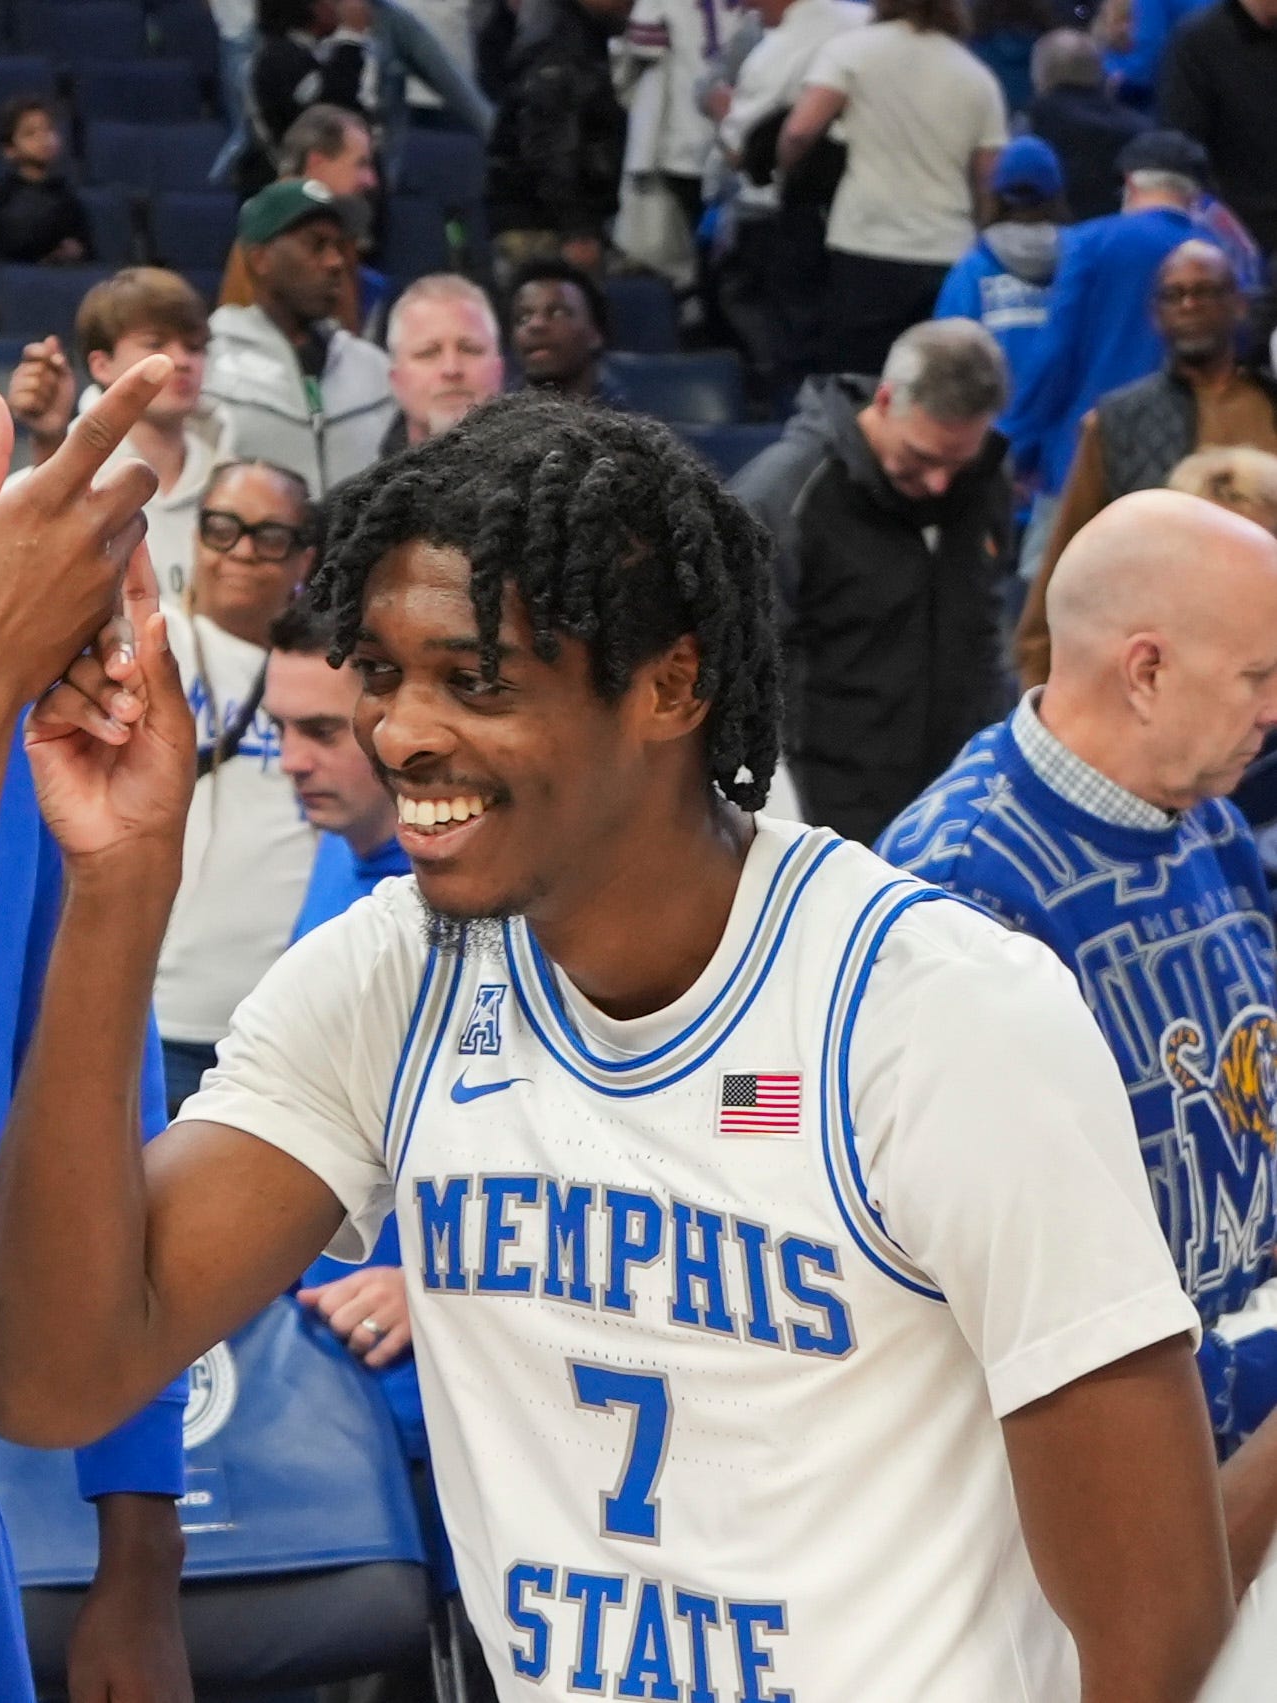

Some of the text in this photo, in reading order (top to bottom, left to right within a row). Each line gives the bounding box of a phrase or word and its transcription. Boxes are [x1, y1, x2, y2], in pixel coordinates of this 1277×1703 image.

[413, 1172, 859, 1361] MEMPHIS
[565, 1356, 675, 1547] 7
[503, 1558, 798, 1703] STATE
